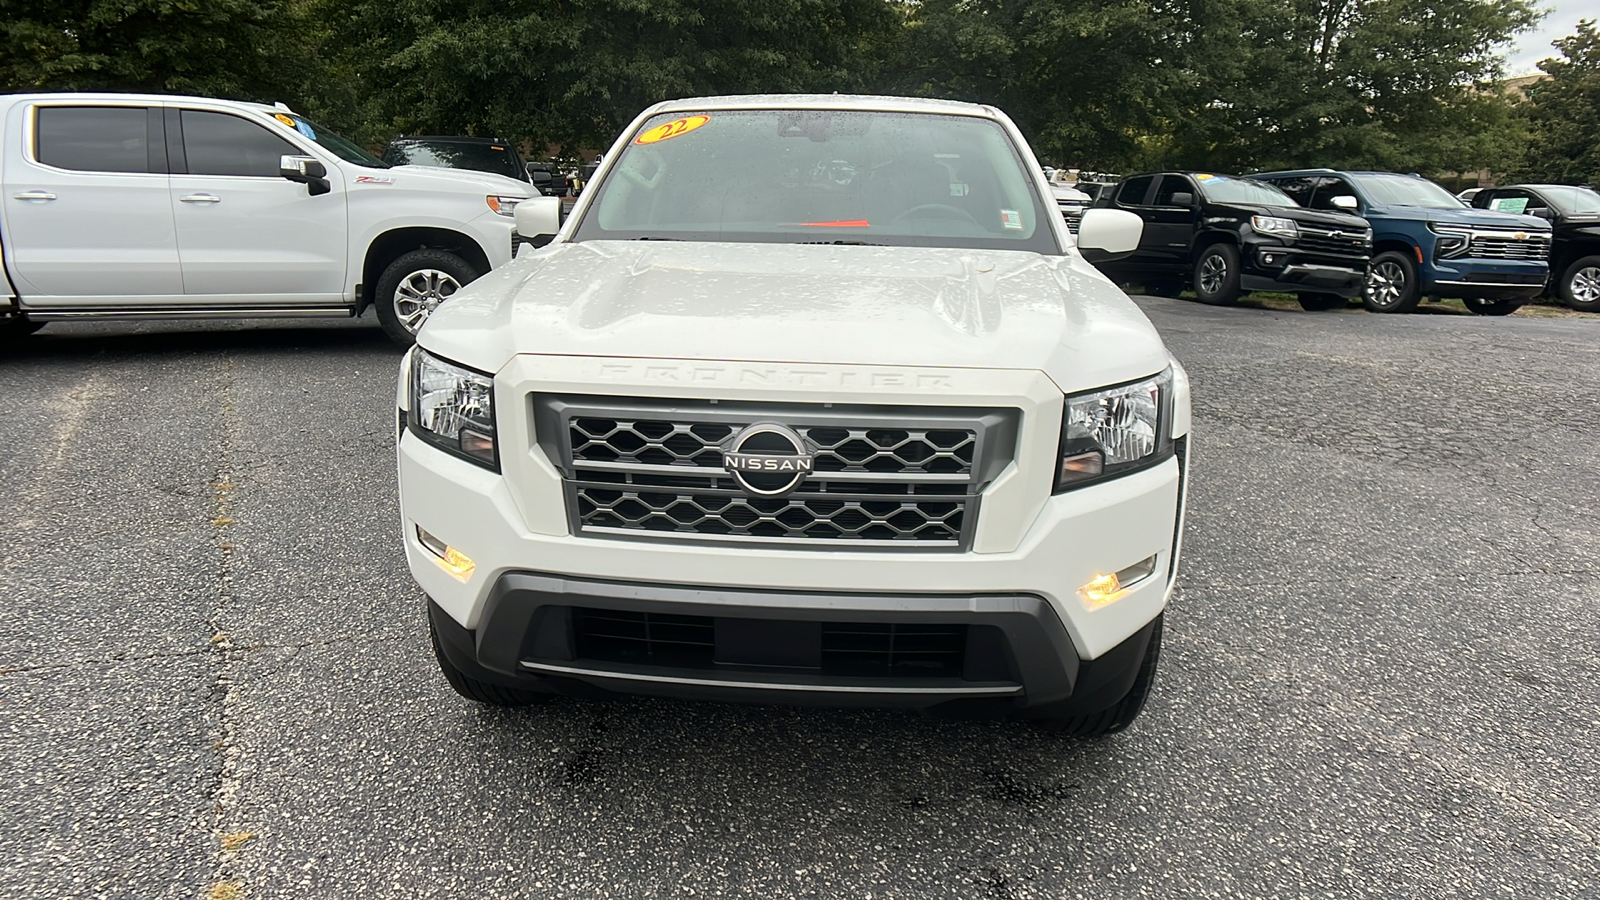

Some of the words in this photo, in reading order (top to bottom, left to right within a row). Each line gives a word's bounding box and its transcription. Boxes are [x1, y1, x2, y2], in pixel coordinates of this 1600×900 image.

[659, 119, 688, 139] 22
[599, 363, 955, 389] FRONTIER
[725, 455, 811, 470] NISSAN
